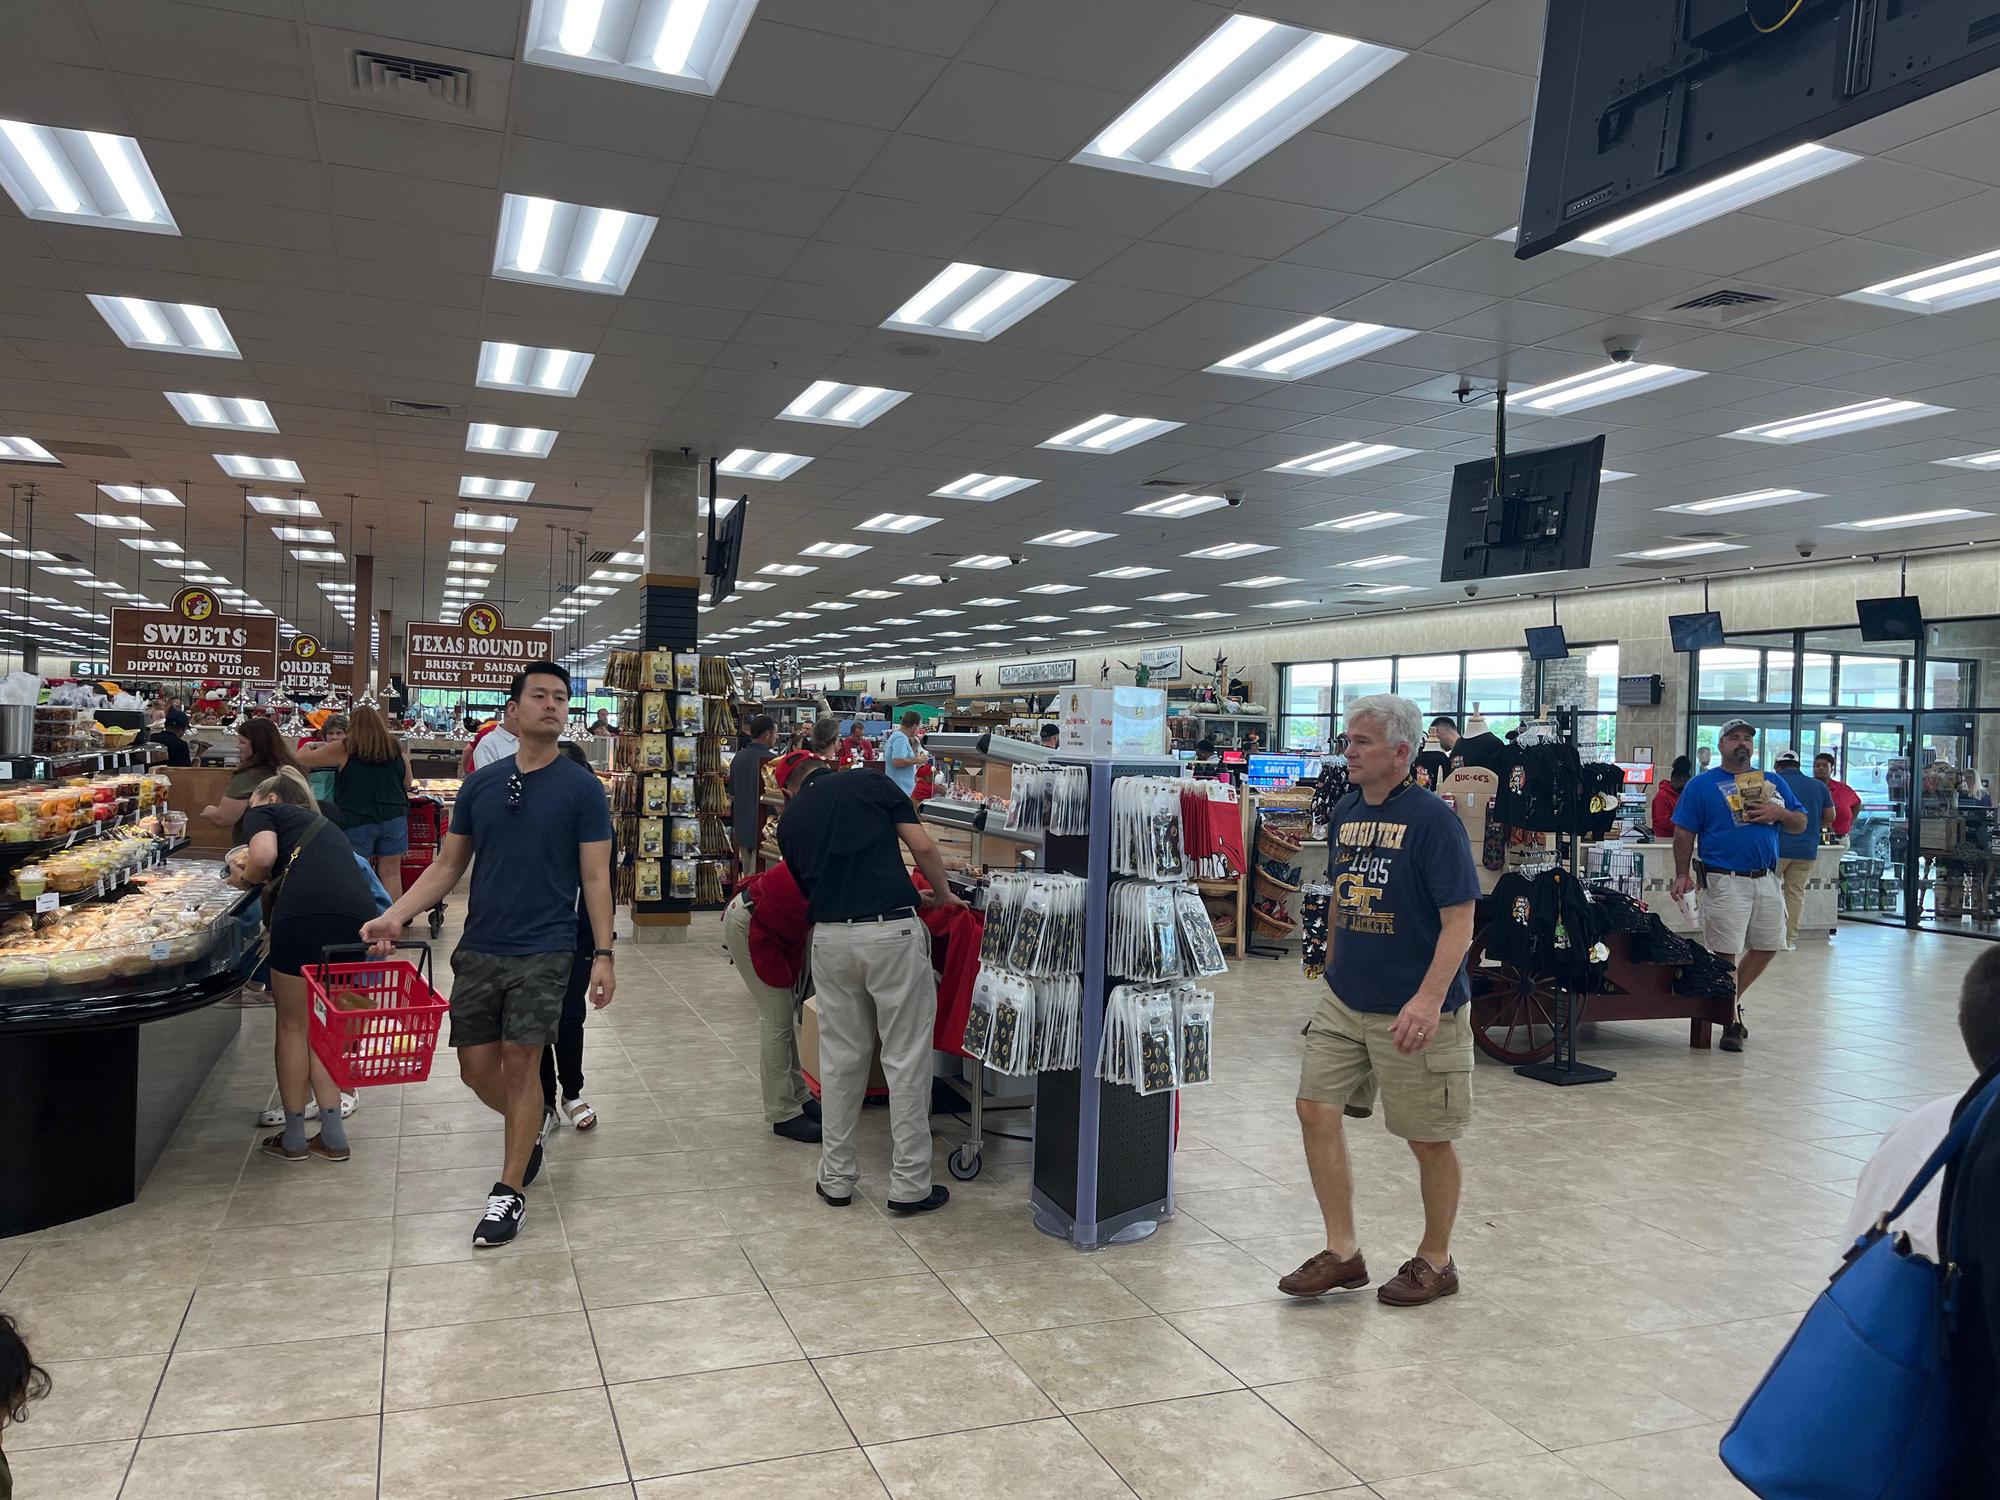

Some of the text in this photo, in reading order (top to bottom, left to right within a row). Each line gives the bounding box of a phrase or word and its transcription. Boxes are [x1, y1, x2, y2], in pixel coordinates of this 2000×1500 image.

[143, 623, 247, 647] SWEETS
[412, 635, 548, 658] TEXAS ROUND UP
[147, 650, 242, 664] SUGARED NUTS
[127, 661, 260, 676] DIPPIN' DOTS FUDGE
[280, 661, 332, 674] ORDER
[425, 659, 475, 671] BRISKET
[287, 675, 329, 688] HERE
[413, 671, 513, 684] TURKEY PULLED
[1264, 766, 1300, 774] SAVE $10
[1335, 873, 1383, 916] GT
